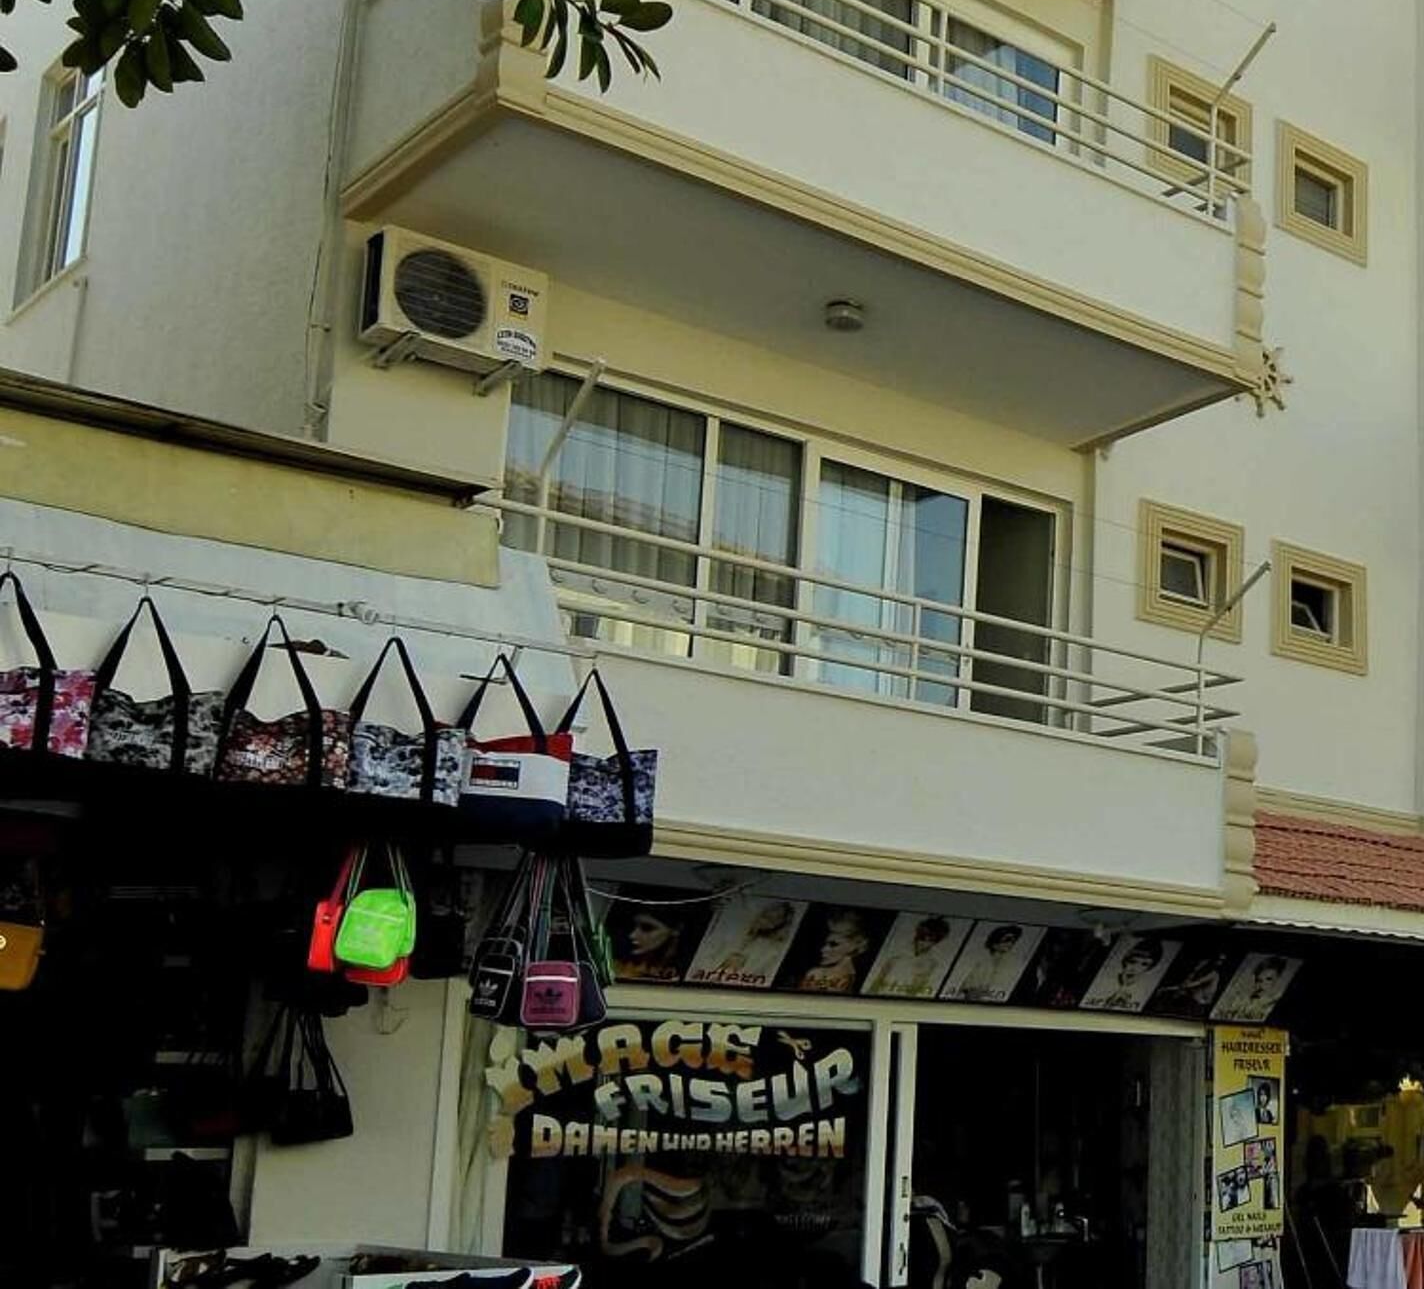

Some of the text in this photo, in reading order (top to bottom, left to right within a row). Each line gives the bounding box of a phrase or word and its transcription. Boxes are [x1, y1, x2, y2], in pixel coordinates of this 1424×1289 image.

[594, 1047, 863, 1124] FRISEUR
[530, 1113, 660, 1158] DAMEN
[716, 1116, 846, 1158] HERREN
